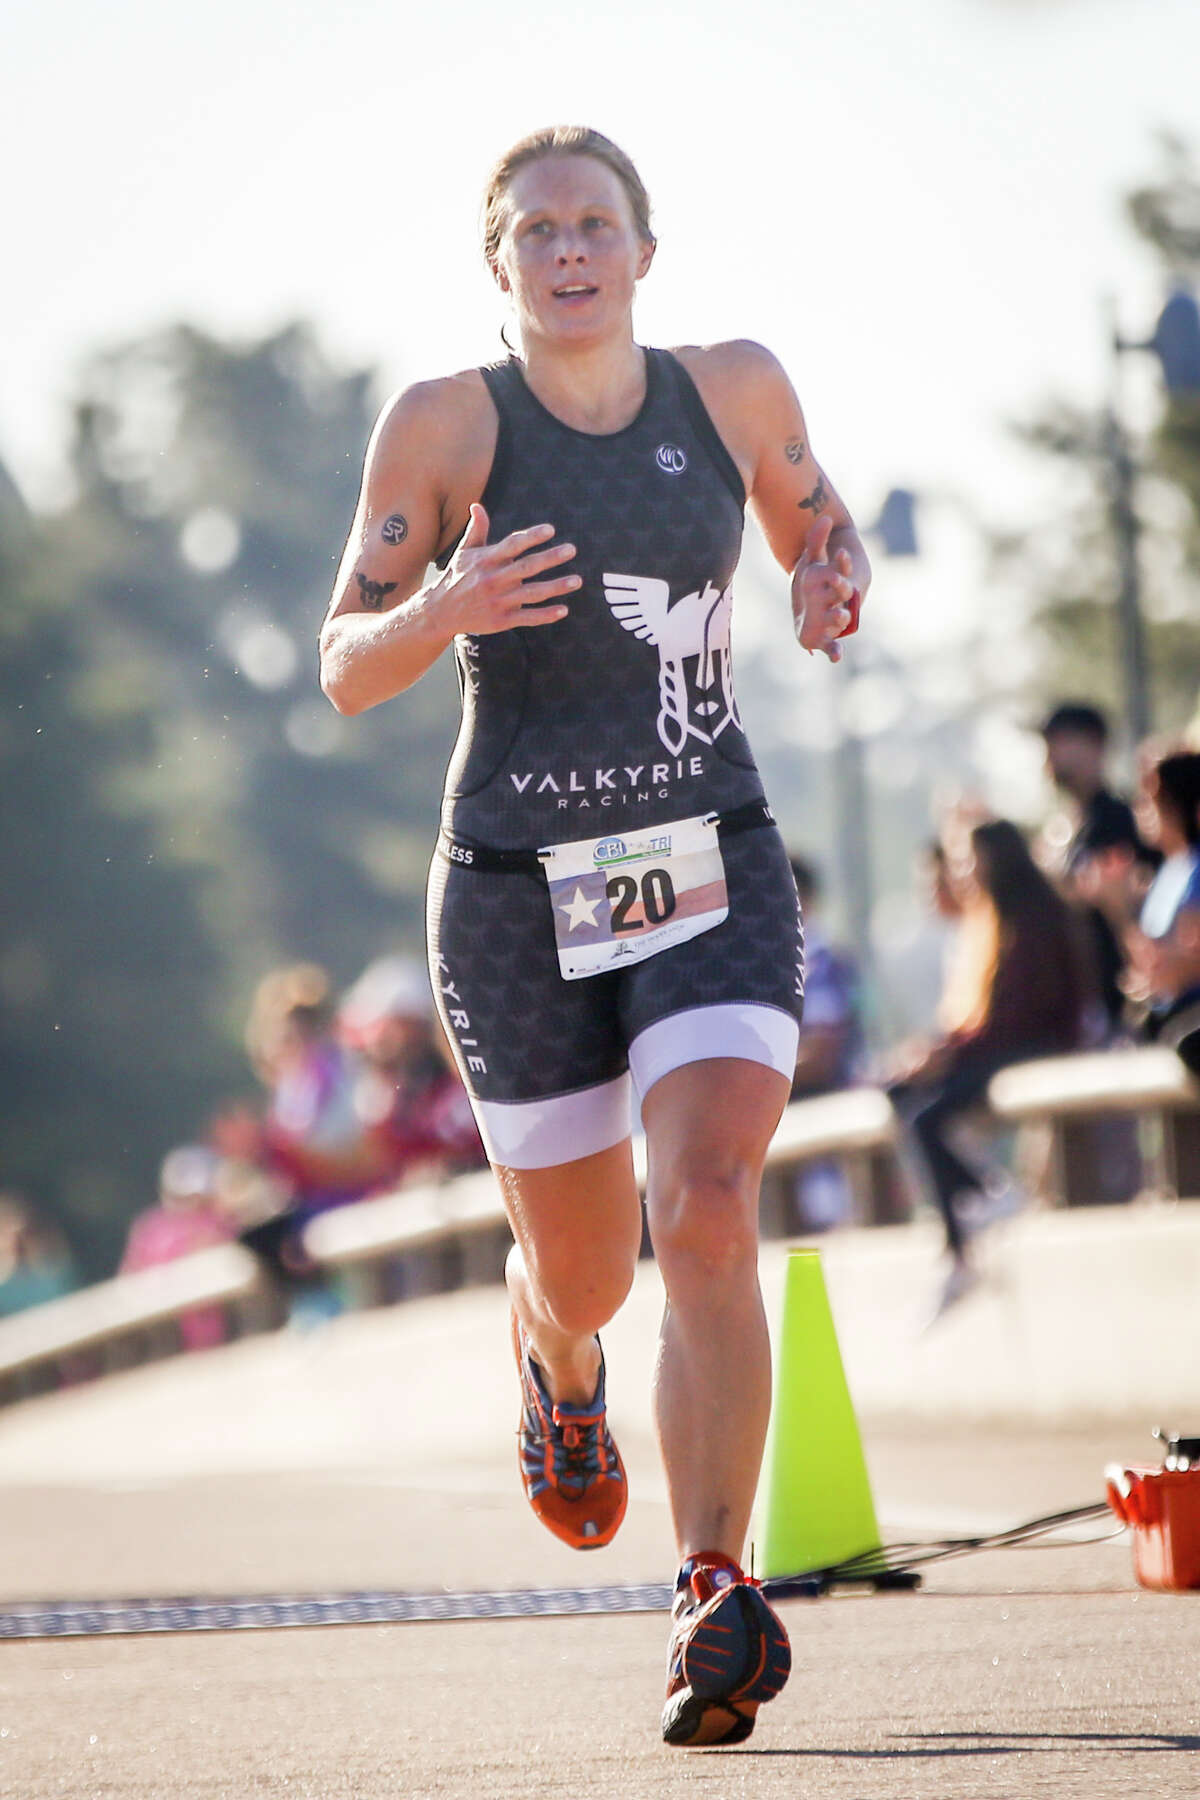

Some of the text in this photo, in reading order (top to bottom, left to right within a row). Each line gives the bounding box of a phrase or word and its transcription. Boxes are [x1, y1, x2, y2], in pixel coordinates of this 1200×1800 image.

[510, 756, 704, 794] VALKYRIE
[557, 788, 669, 809] RACING
[649, 835, 672, 850] TRI
[605, 868, 677, 934] 20
